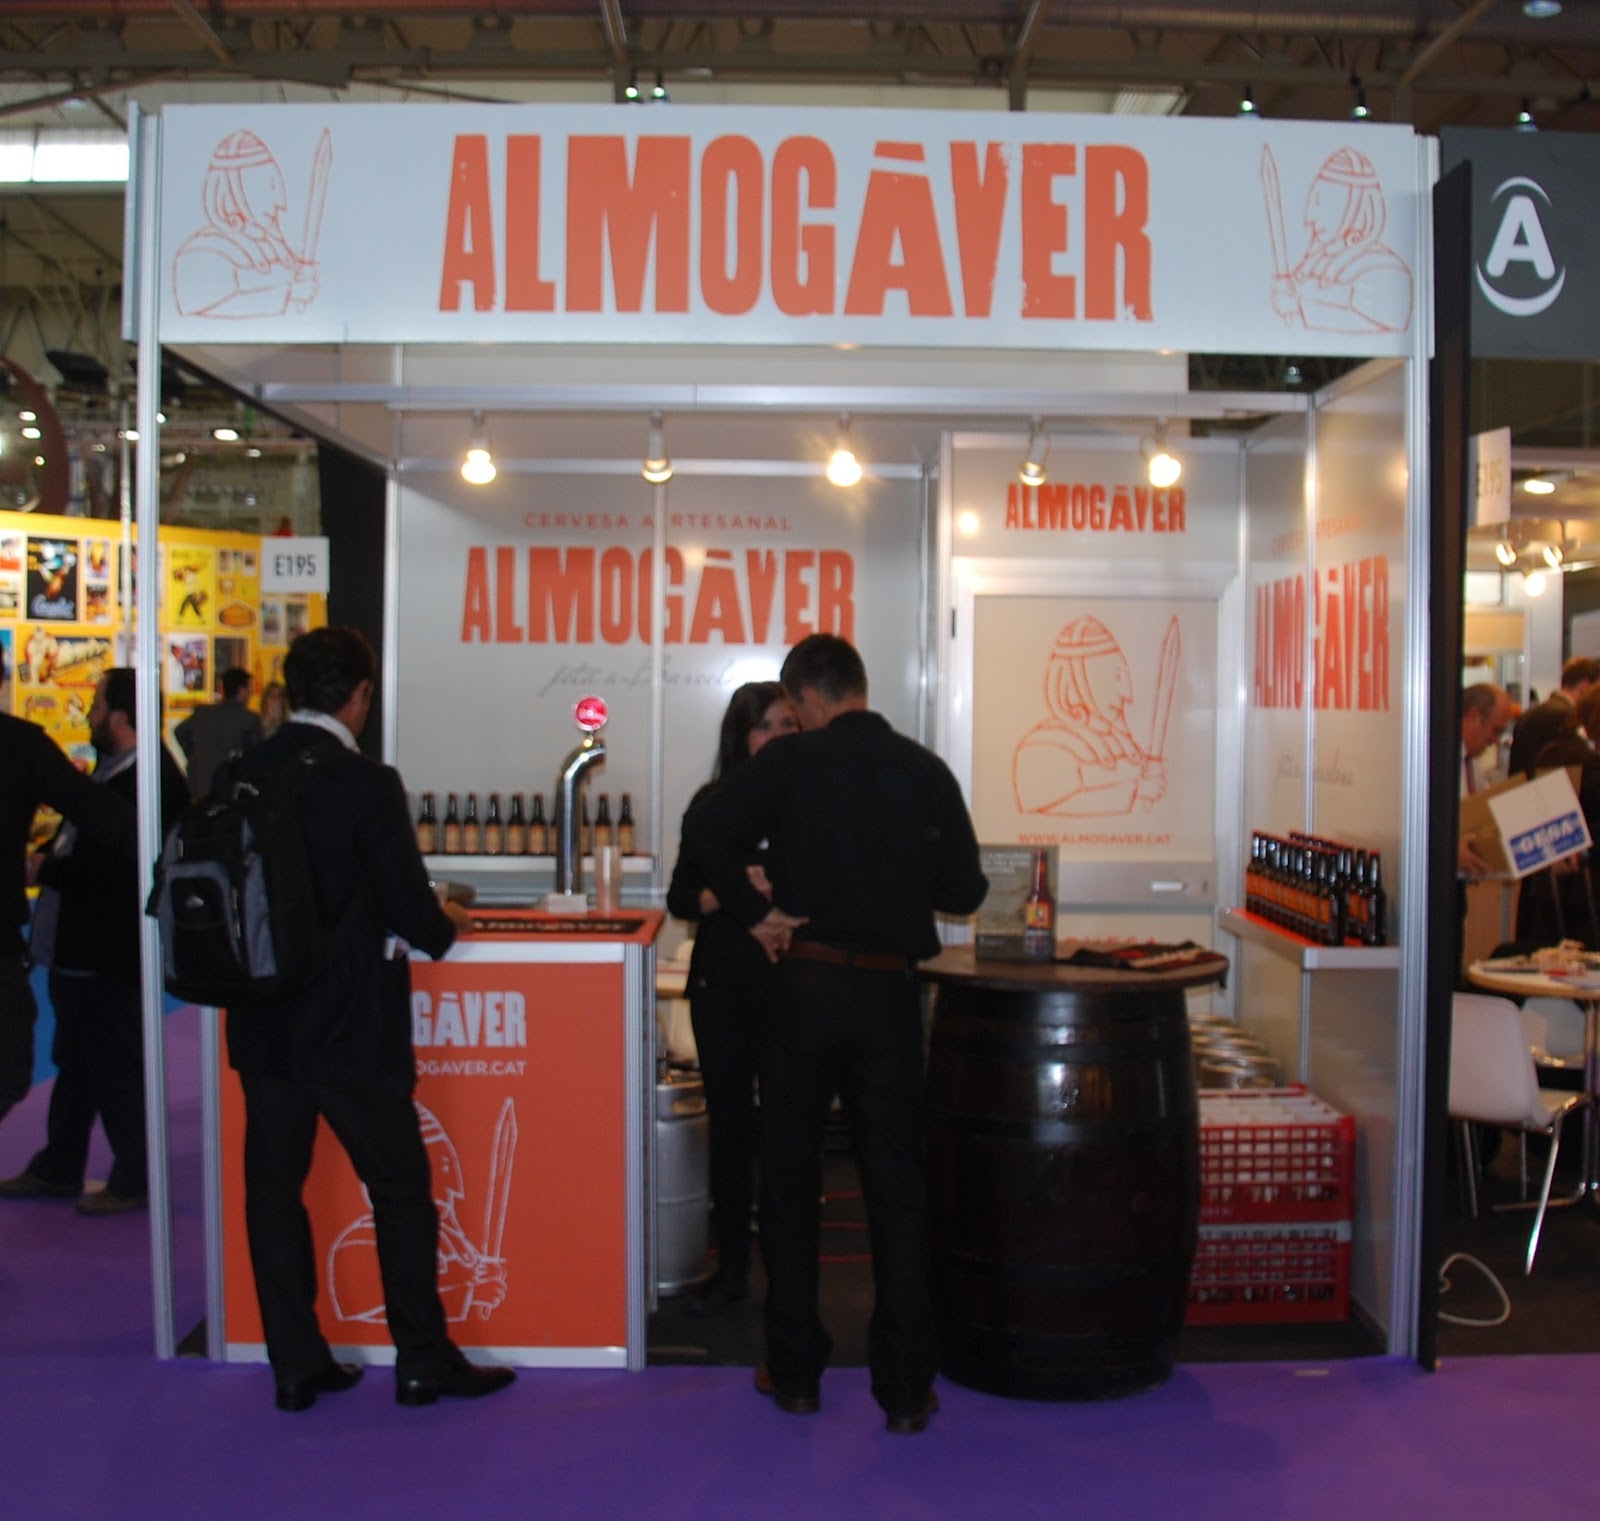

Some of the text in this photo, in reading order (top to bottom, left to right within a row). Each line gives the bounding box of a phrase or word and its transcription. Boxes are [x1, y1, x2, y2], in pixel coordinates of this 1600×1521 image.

[1486, 194, 1556, 280] A
[523, 512, 630, 529] CERVESA
[275, 554, 317, 577] E195
[416, 1060, 527, 1076] OGAVER.CAT
